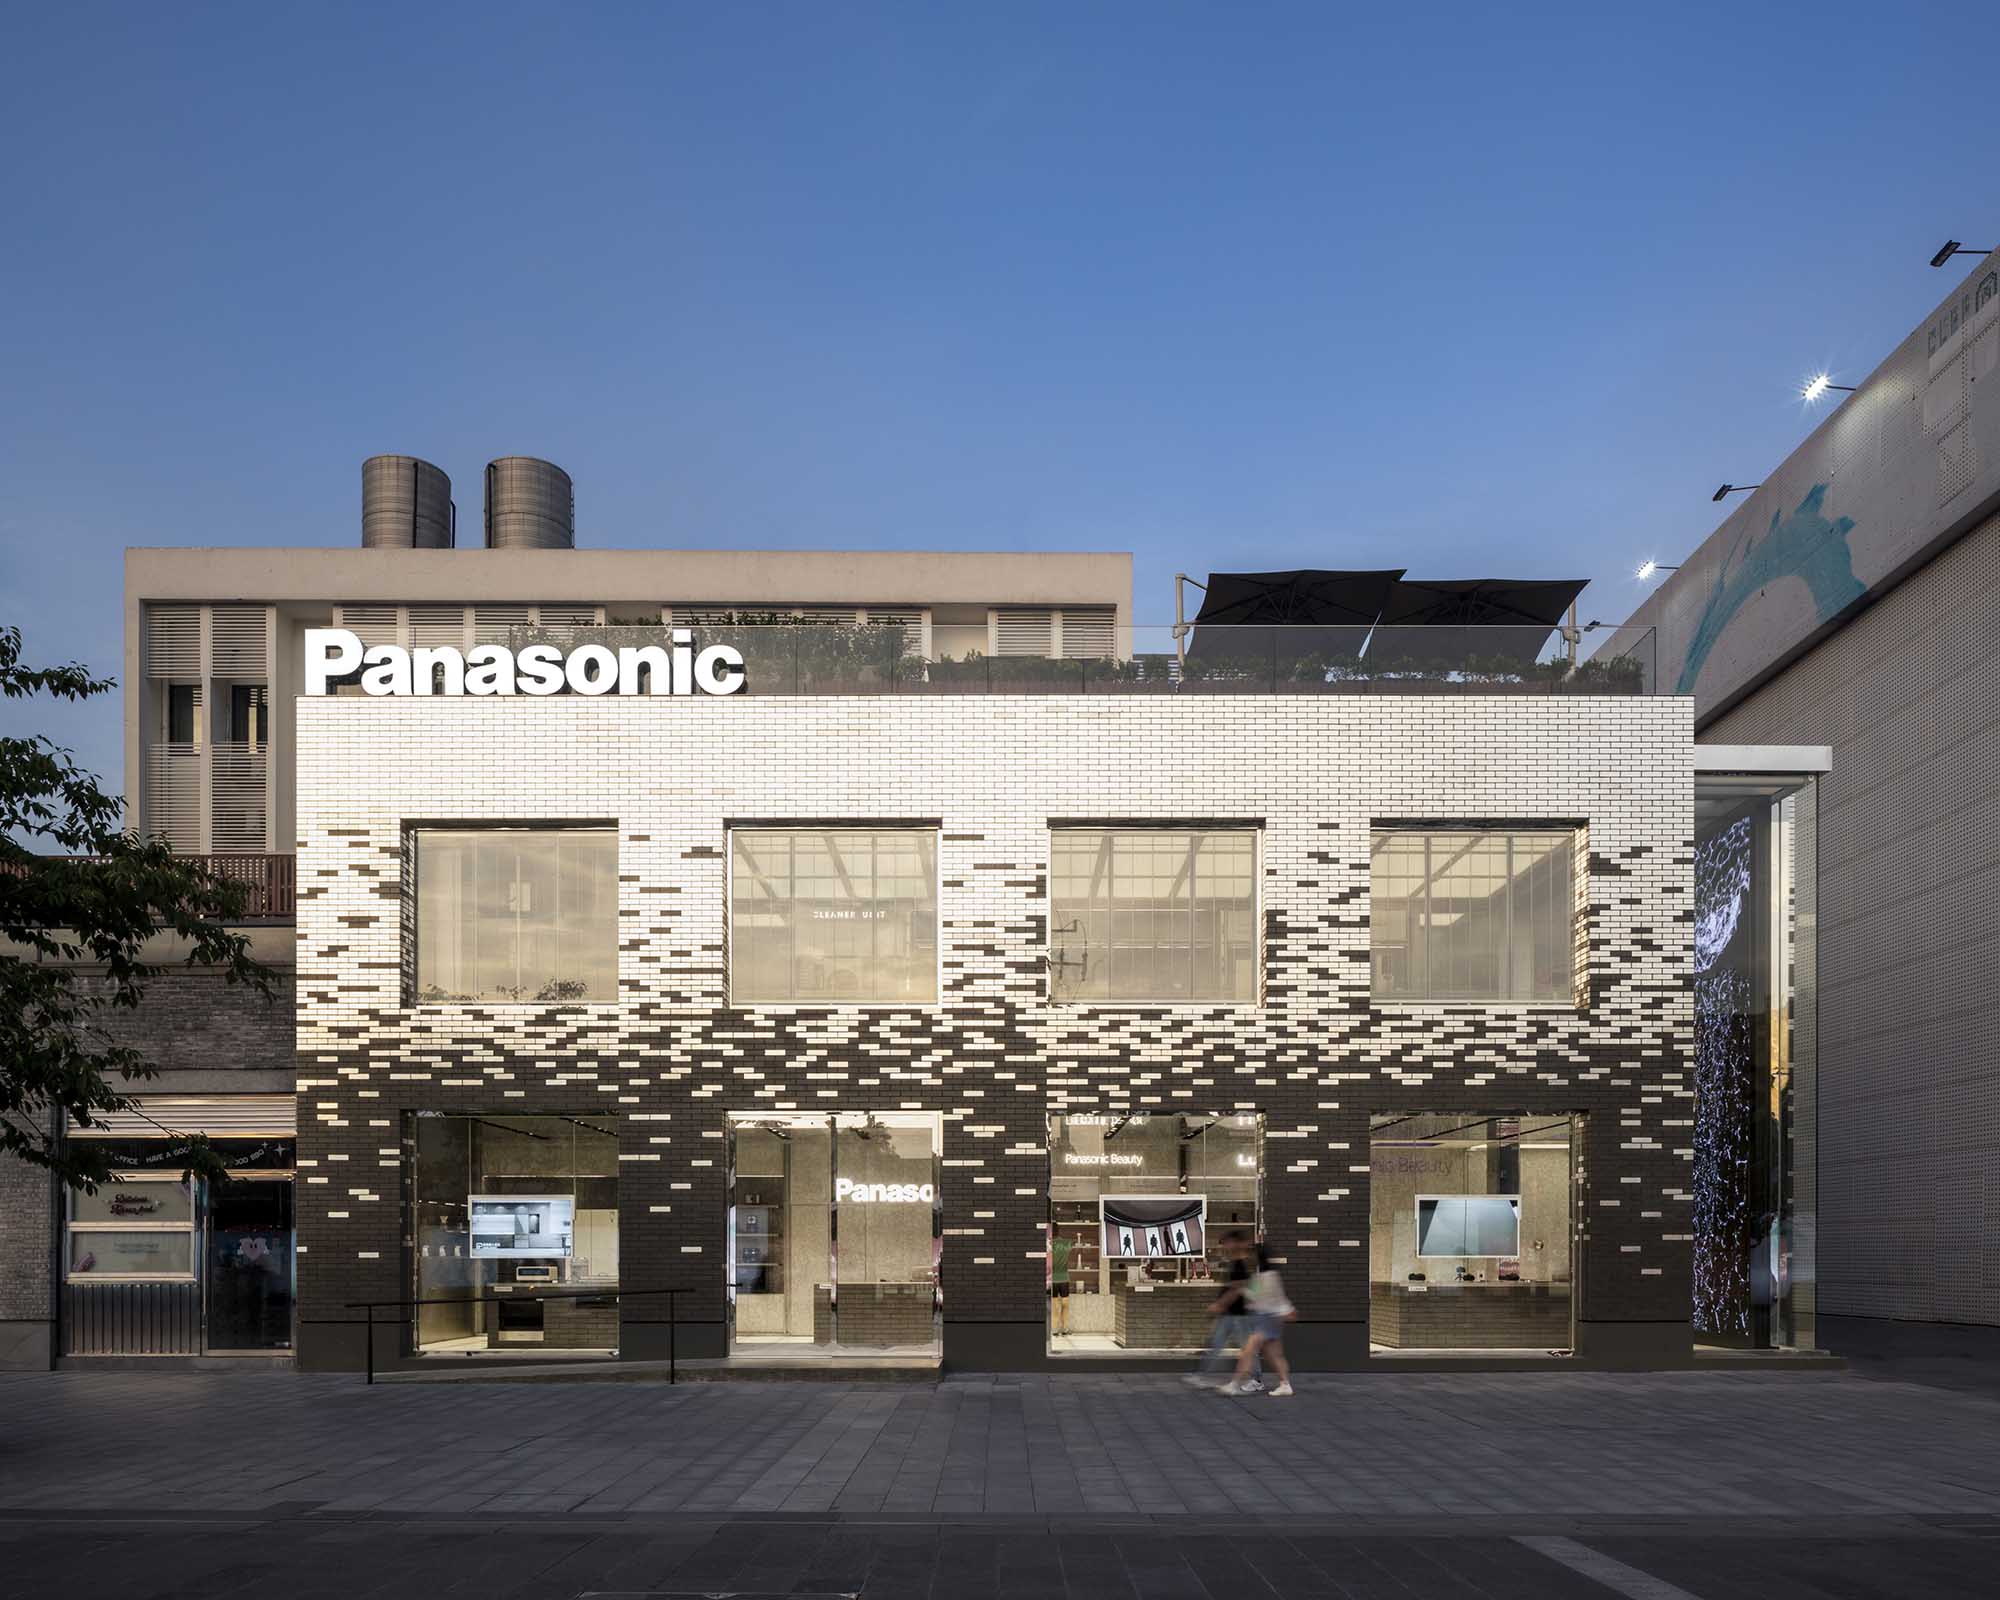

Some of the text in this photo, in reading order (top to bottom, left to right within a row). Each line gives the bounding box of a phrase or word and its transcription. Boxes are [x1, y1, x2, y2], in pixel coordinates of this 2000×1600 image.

[304, 628, 745, 696] Panasonic
[1065, 1152, 1143, 1167] Panasonic Beauty
[1398, 1157, 1453, 1174] Beauty
